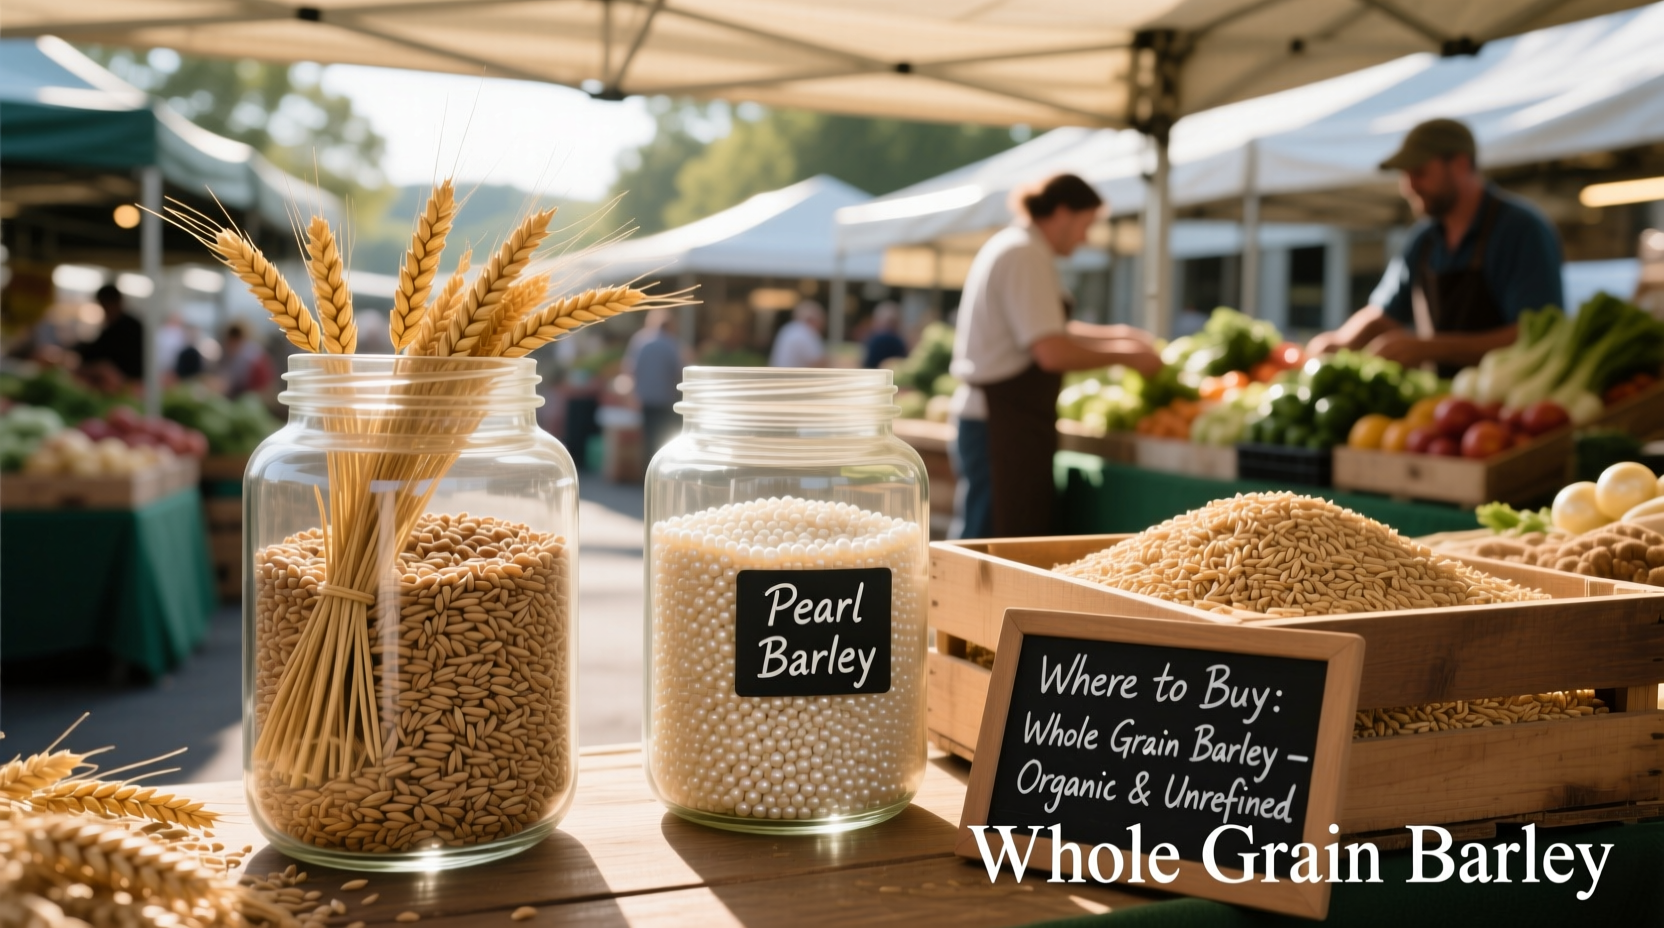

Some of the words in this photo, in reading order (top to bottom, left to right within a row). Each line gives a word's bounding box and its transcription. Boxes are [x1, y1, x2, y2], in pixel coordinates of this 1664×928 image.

[765, 582, 864, 626] Pearl
[757, 634, 876, 689] Barley
[1040, 653, 1138, 698] Where
[1153, 662, 1188, 702] to
[1199, 664, 1283, 724] Buy:
[1023, 711, 1098, 750] Whole
[1110, 719, 1179, 758] Grain
[1189, 724, 1278, 783] Barley
[1016, 759, 1117, 813] Organic
[1128, 770, 1151, 807] &
[1164, 774, 1297, 824] Unrefined
